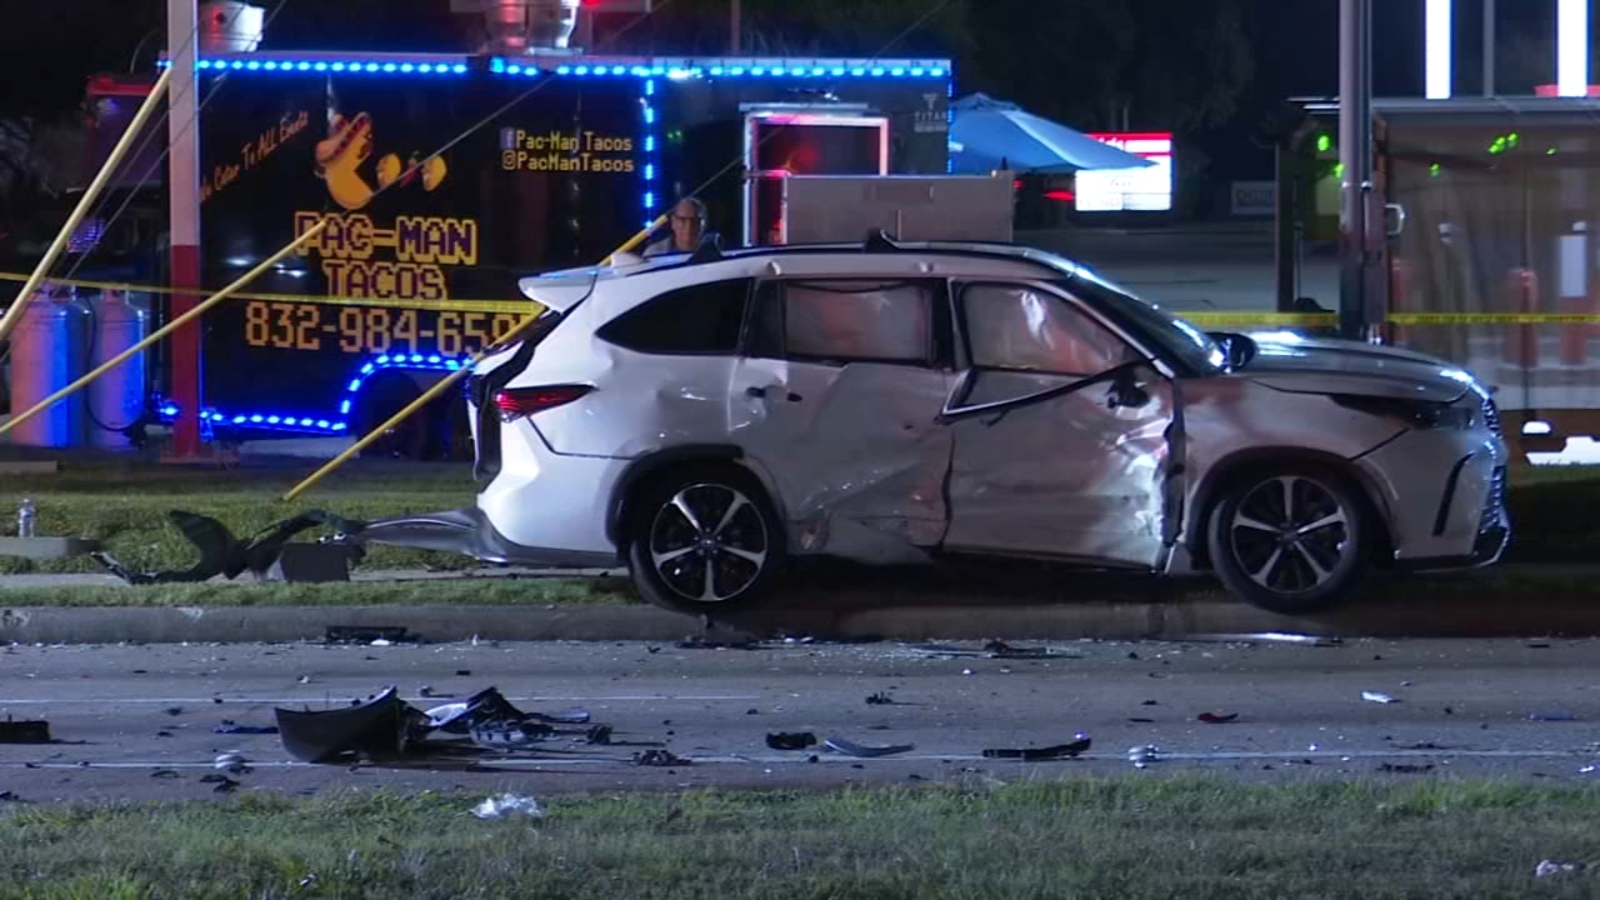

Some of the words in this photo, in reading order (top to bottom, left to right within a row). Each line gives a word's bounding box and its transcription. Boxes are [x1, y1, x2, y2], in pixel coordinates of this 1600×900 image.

[516, 129, 579, 150] Pac-Man
[583, 130, 633, 151] Tacos
[501, 149, 634, 172] @PacManTacos
[294, 211, 477, 265] PAC-MAN
[322, 259, 448, 300] TACOS
